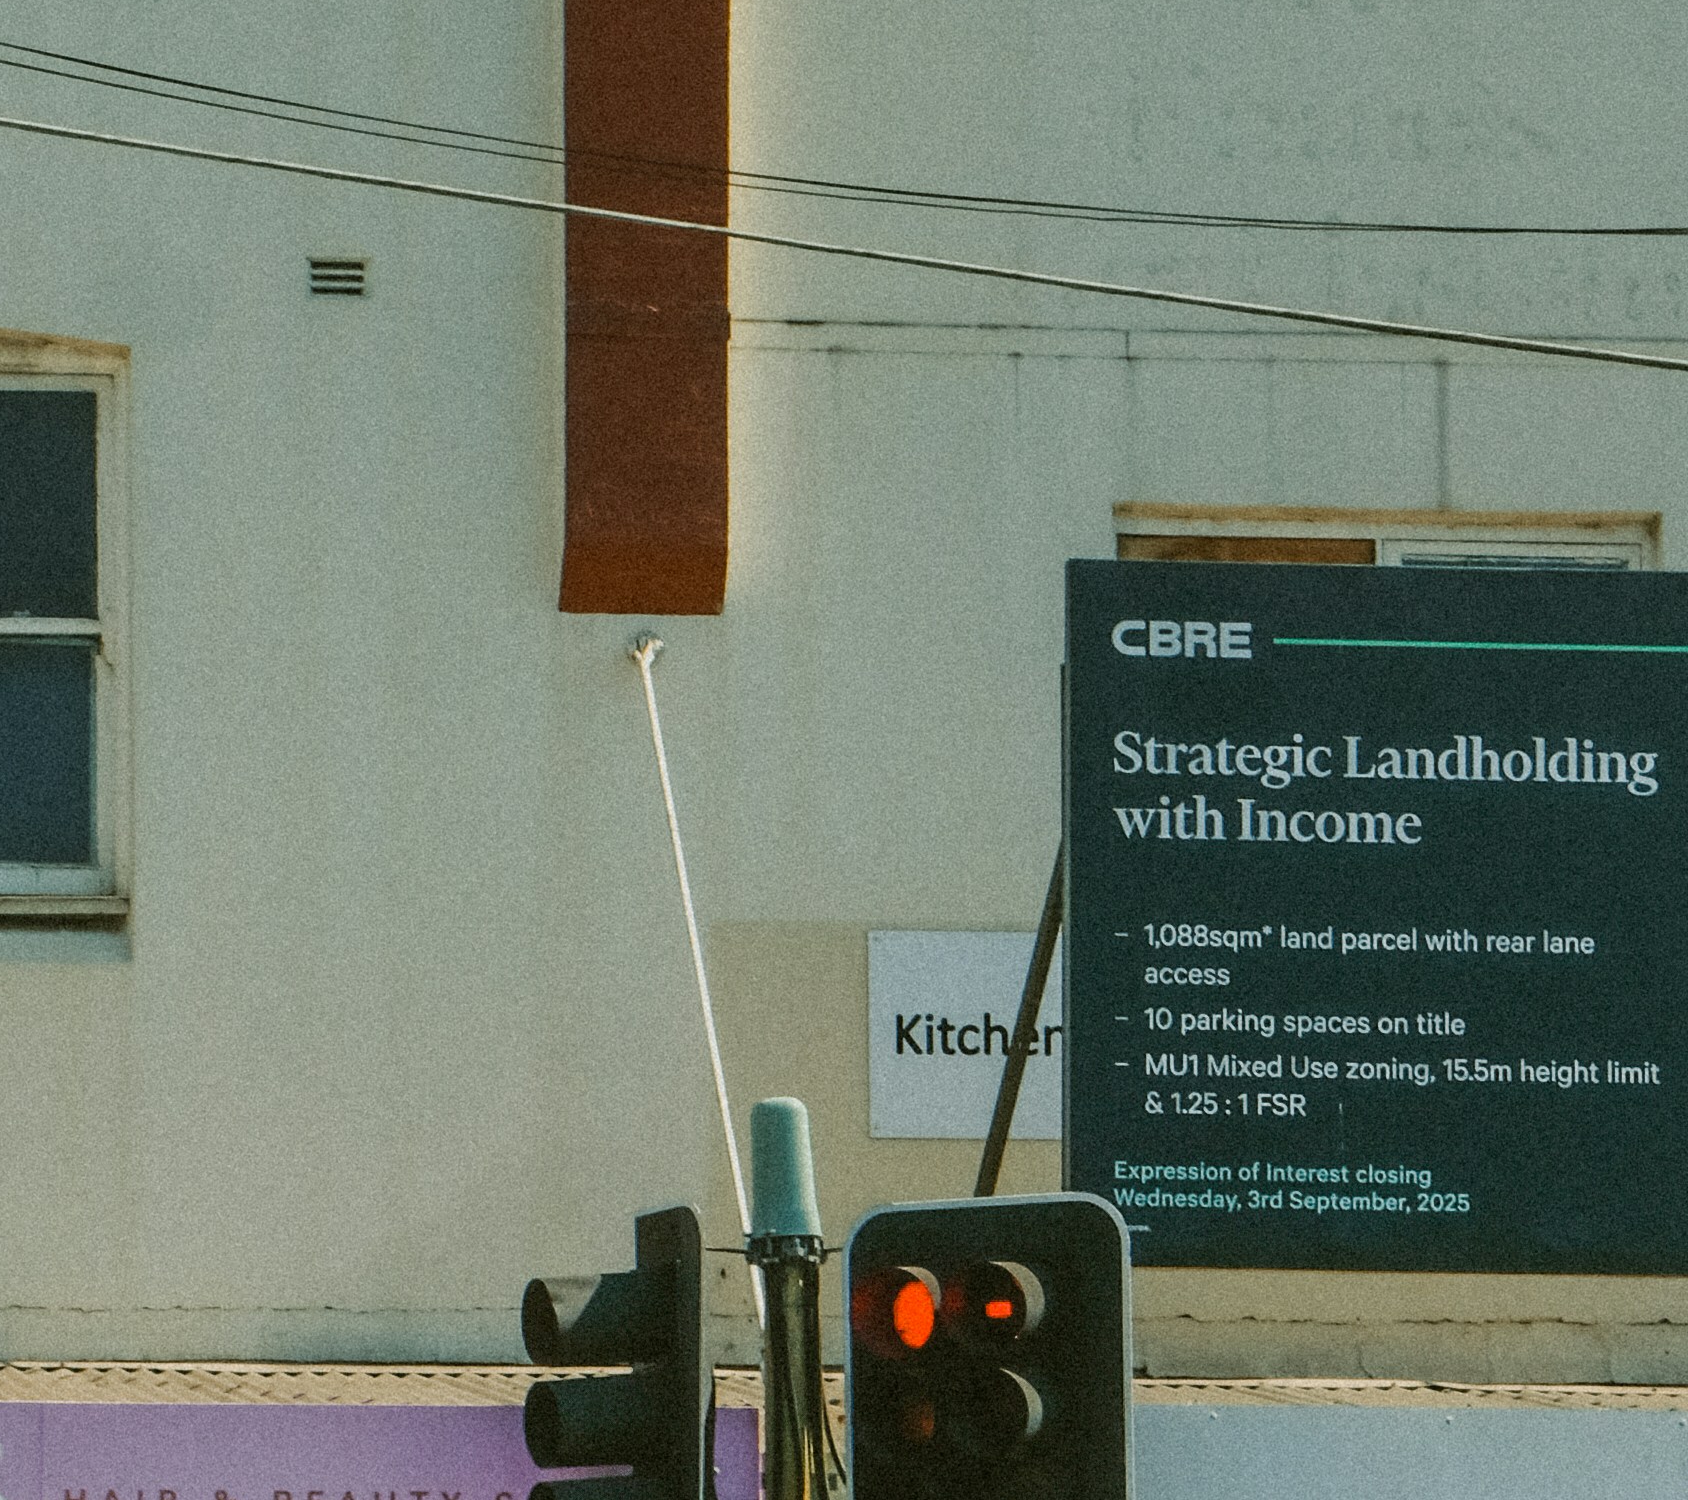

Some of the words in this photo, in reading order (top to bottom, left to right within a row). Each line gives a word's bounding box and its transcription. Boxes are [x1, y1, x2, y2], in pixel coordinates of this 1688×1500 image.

[1111, 620, 1252, 659] CBRE
[1113, 730, 1332, 790] Strategic
[1344, 735, 1659, 796] Landholding
[1114, 794, 1225, 840] with
[1237, 798, 1422, 844] Income
[1280, 924, 1333, 950] land
[1341, 927, 1418, 955] parcel
[1424, 929, 1479, 952] with
[1486, 935, 1536, 954] rear
[1543, 930, 1595, 955] lane
[1144, 966, 1231, 986] access
[1144, 1006, 1173, 1031] 10
[1180, 1007, 1276, 1038] parking
[1283, 1014, 1371, 1038] spaces
[1377, 1016, 1409, 1035] on
[1416, 1011, 1466, 1036] title
[1145, 1053, 1199, 1076] MU1
[1207, 1054, 1283, 1078] Mixed
[1290, 1056, 1339, 1079] Use
[1345, 1057, 1436, 1087] zoning,
[1442, 1058, 1512, 1082] 15.5m
[1520, 1058, 1599, 1089] height
[1607, 1060, 1660, 1085] limit
[1144, 1090, 1164, 1114] &
[1171, 1091, 1219, 1115] 1.25
[1238, 1092, 1249, 1115] 1
[1257, 1092, 1306, 1117] FSR
[1114, 1160, 1232, 1184] Expression
[1238, 1161, 1260, 1182] of
[1266, 1163, 1349, 1183] Interest
[1355, 1164, 1432, 1190] closing
[1113, 1188, 1242, 1212] Wednesday,
[1248, 1189, 1283, 1209] 3rd
[1289, 1190, 1412, 1214] September,
[1417, 1192, 1470, 1212] 2025
